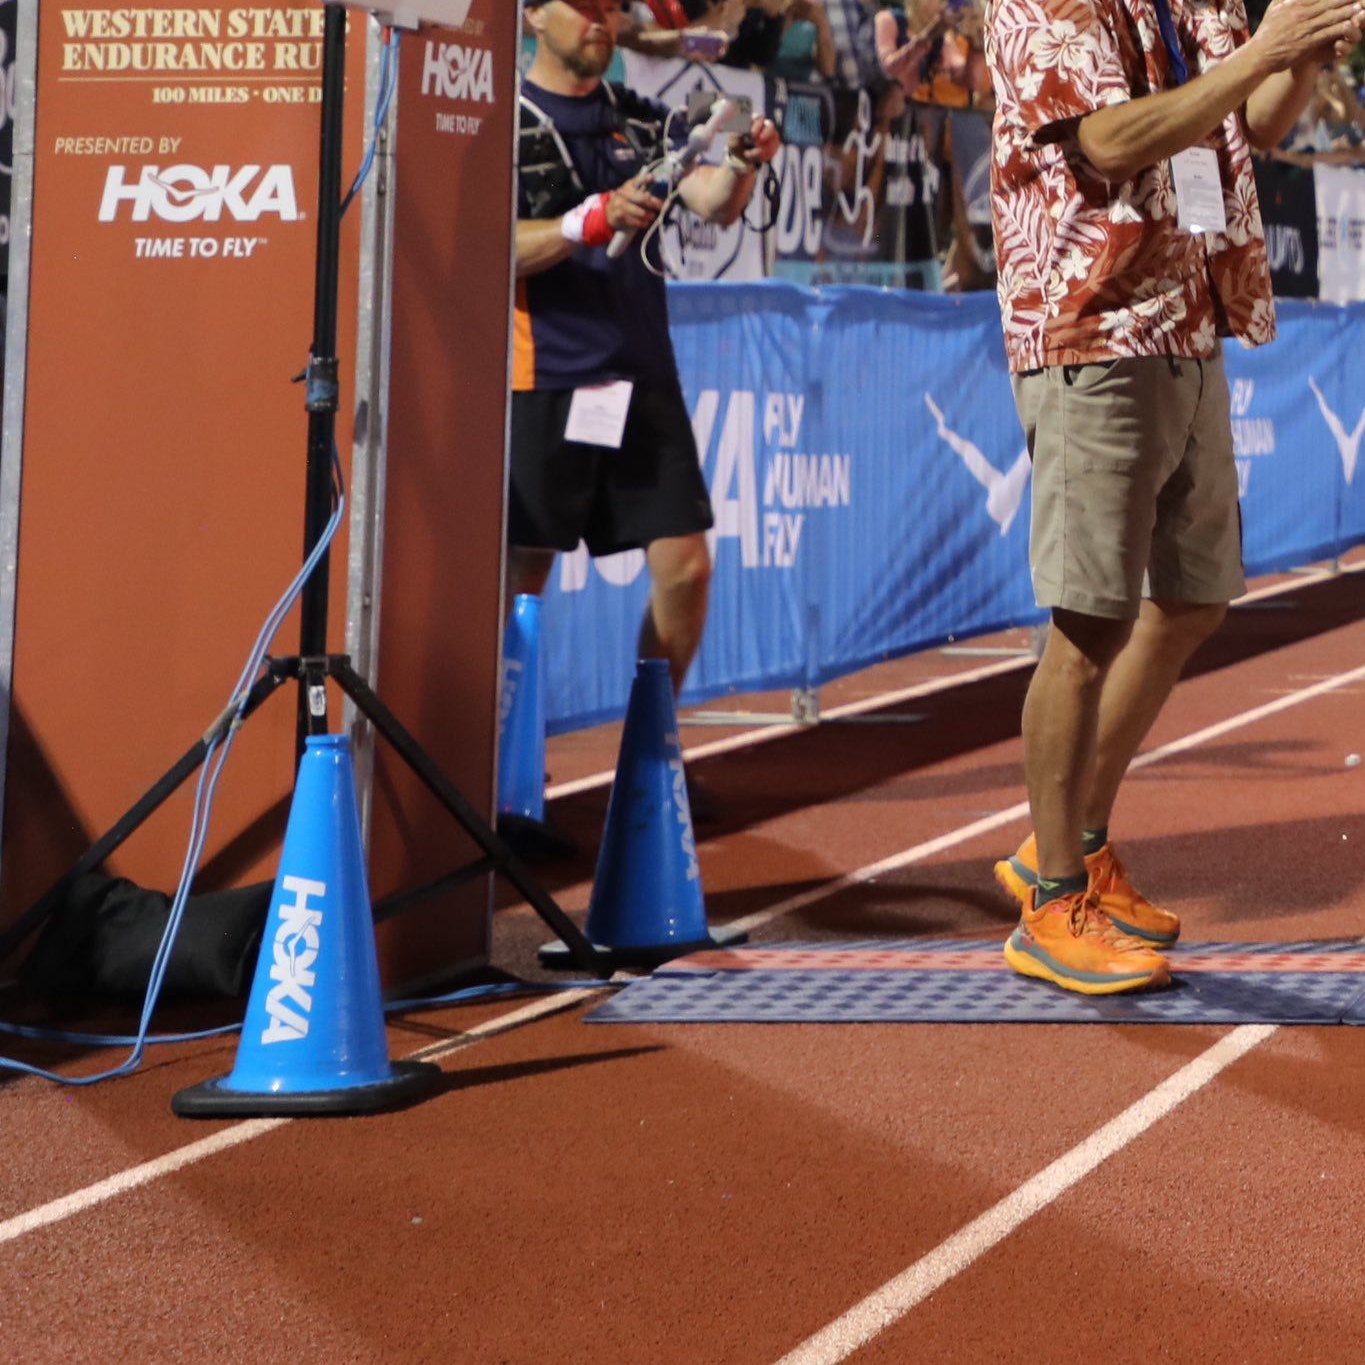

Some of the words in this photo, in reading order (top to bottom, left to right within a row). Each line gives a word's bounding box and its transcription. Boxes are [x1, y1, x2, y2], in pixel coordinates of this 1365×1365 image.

[61, 9, 221, 38] WESTERN
[227, 9, 351, 38] STATE
[62, 43, 265, 71] ENDURANCE
[421, 41, 495, 103] HOKA
[153, 87, 184, 103] 100
[188, 87, 249, 103] MILES
[263, 87, 304, 103] ONE
[54, 137, 154, 155] PRESENTED
[158, 137, 182, 154] BY
[98, 164, 299, 223] HOKA
[134, 238, 185, 258] TIME
[190, 238, 219, 257] TO
[764, 392, 804, 447] FLY
[763, 513, 805, 568] FLY
[261, 874, 327, 1045] HOKA
